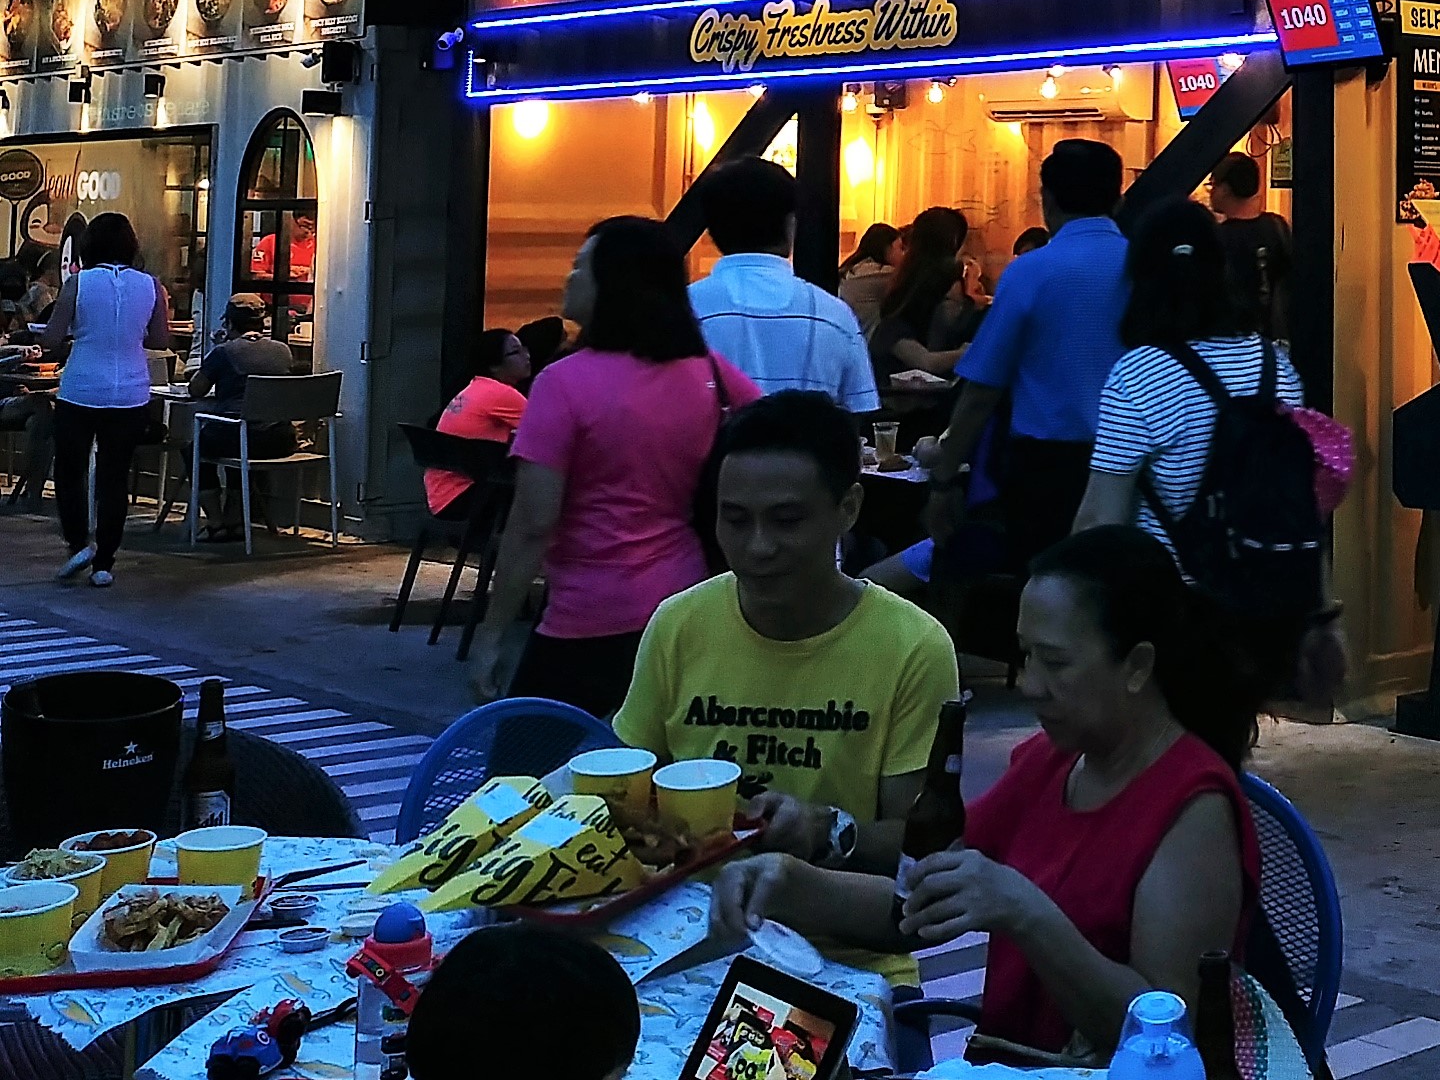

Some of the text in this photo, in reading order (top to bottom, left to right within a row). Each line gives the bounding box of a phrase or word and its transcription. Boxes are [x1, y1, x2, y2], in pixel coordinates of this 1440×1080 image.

[1280, 3, 1327, 30] 1040
[694, 16, 759, 66] Crispy
[767, 4, 869, 50] Freshness
[1177, 73, 1216, 93] 1040
[683, 694, 871, 732] Abercrombie
[102, 753, 154, 770] Heineken
[746, 733, 823, 770] Fitch
[576, 842, 629, 876] eat
